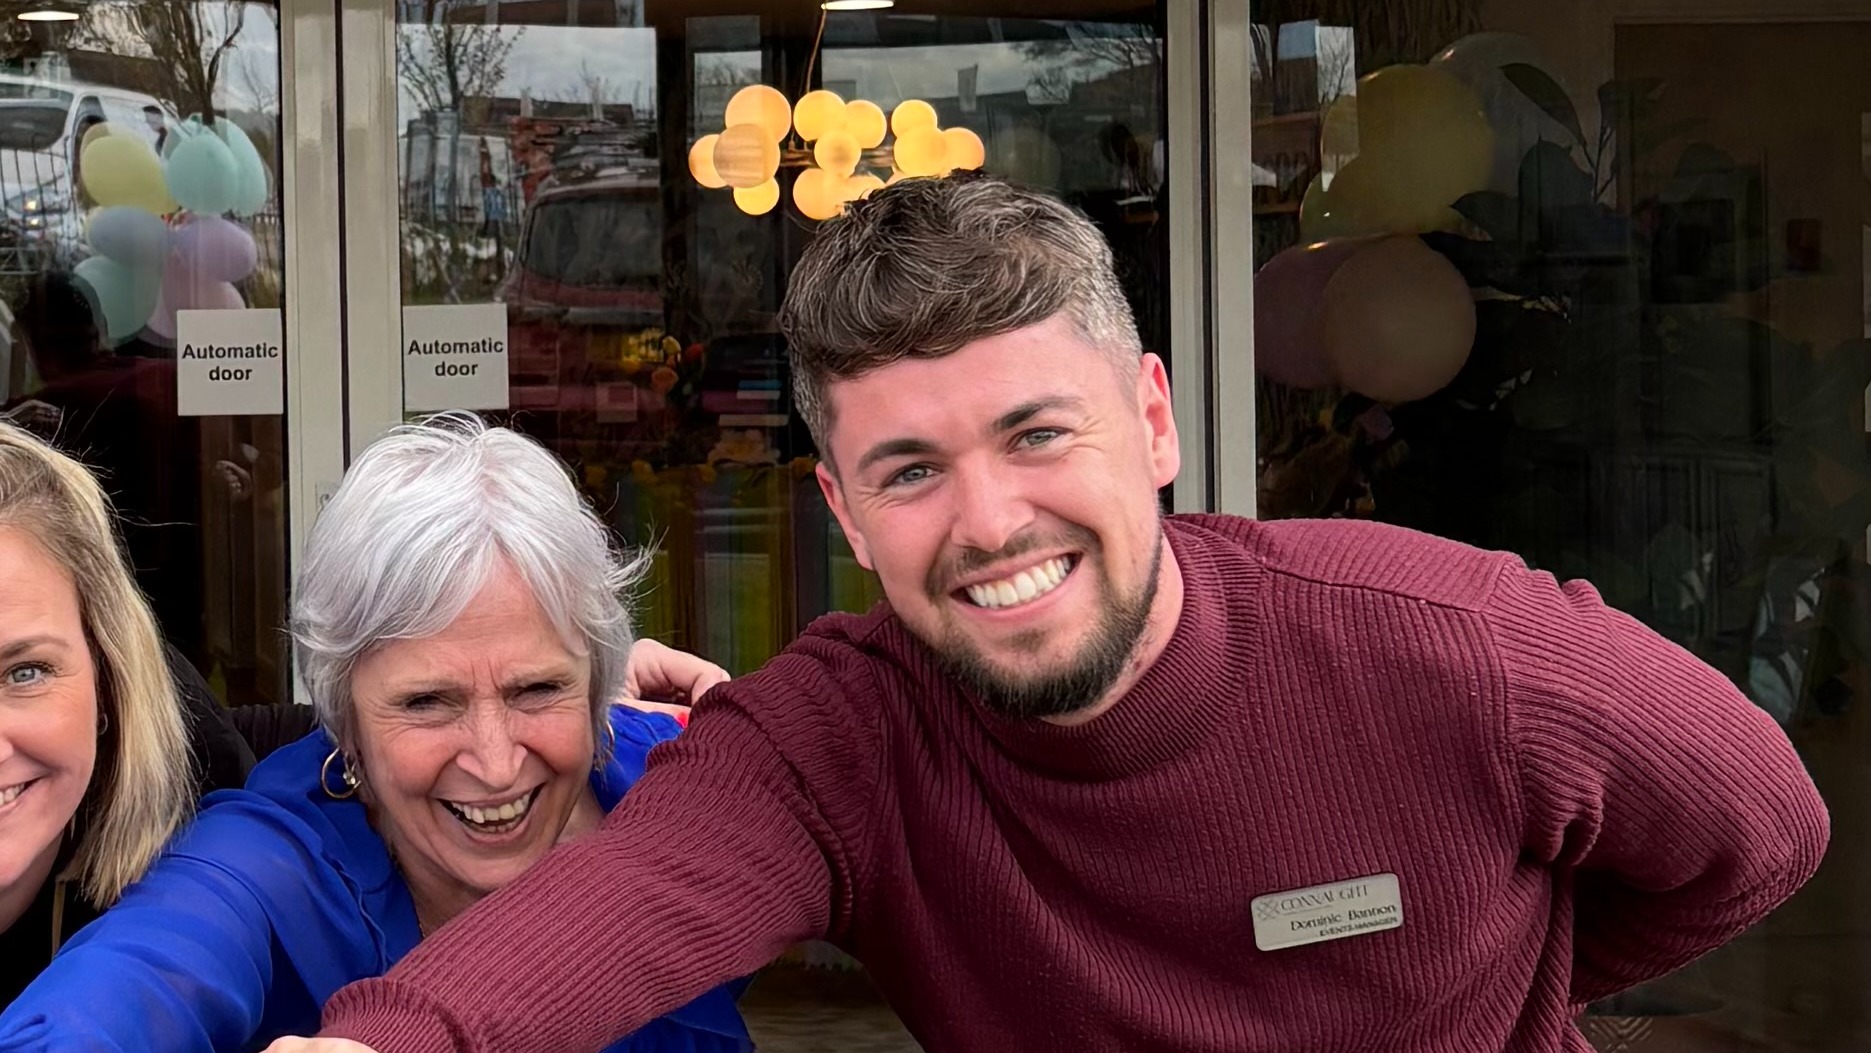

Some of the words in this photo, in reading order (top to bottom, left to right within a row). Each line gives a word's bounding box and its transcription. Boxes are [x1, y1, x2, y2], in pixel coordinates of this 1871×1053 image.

[182, 342, 278, 360] Automatic
[408, 337, 504, 356] Automatic
[208, 365, 253, 382] door
[434, 360, 479, 377] door
